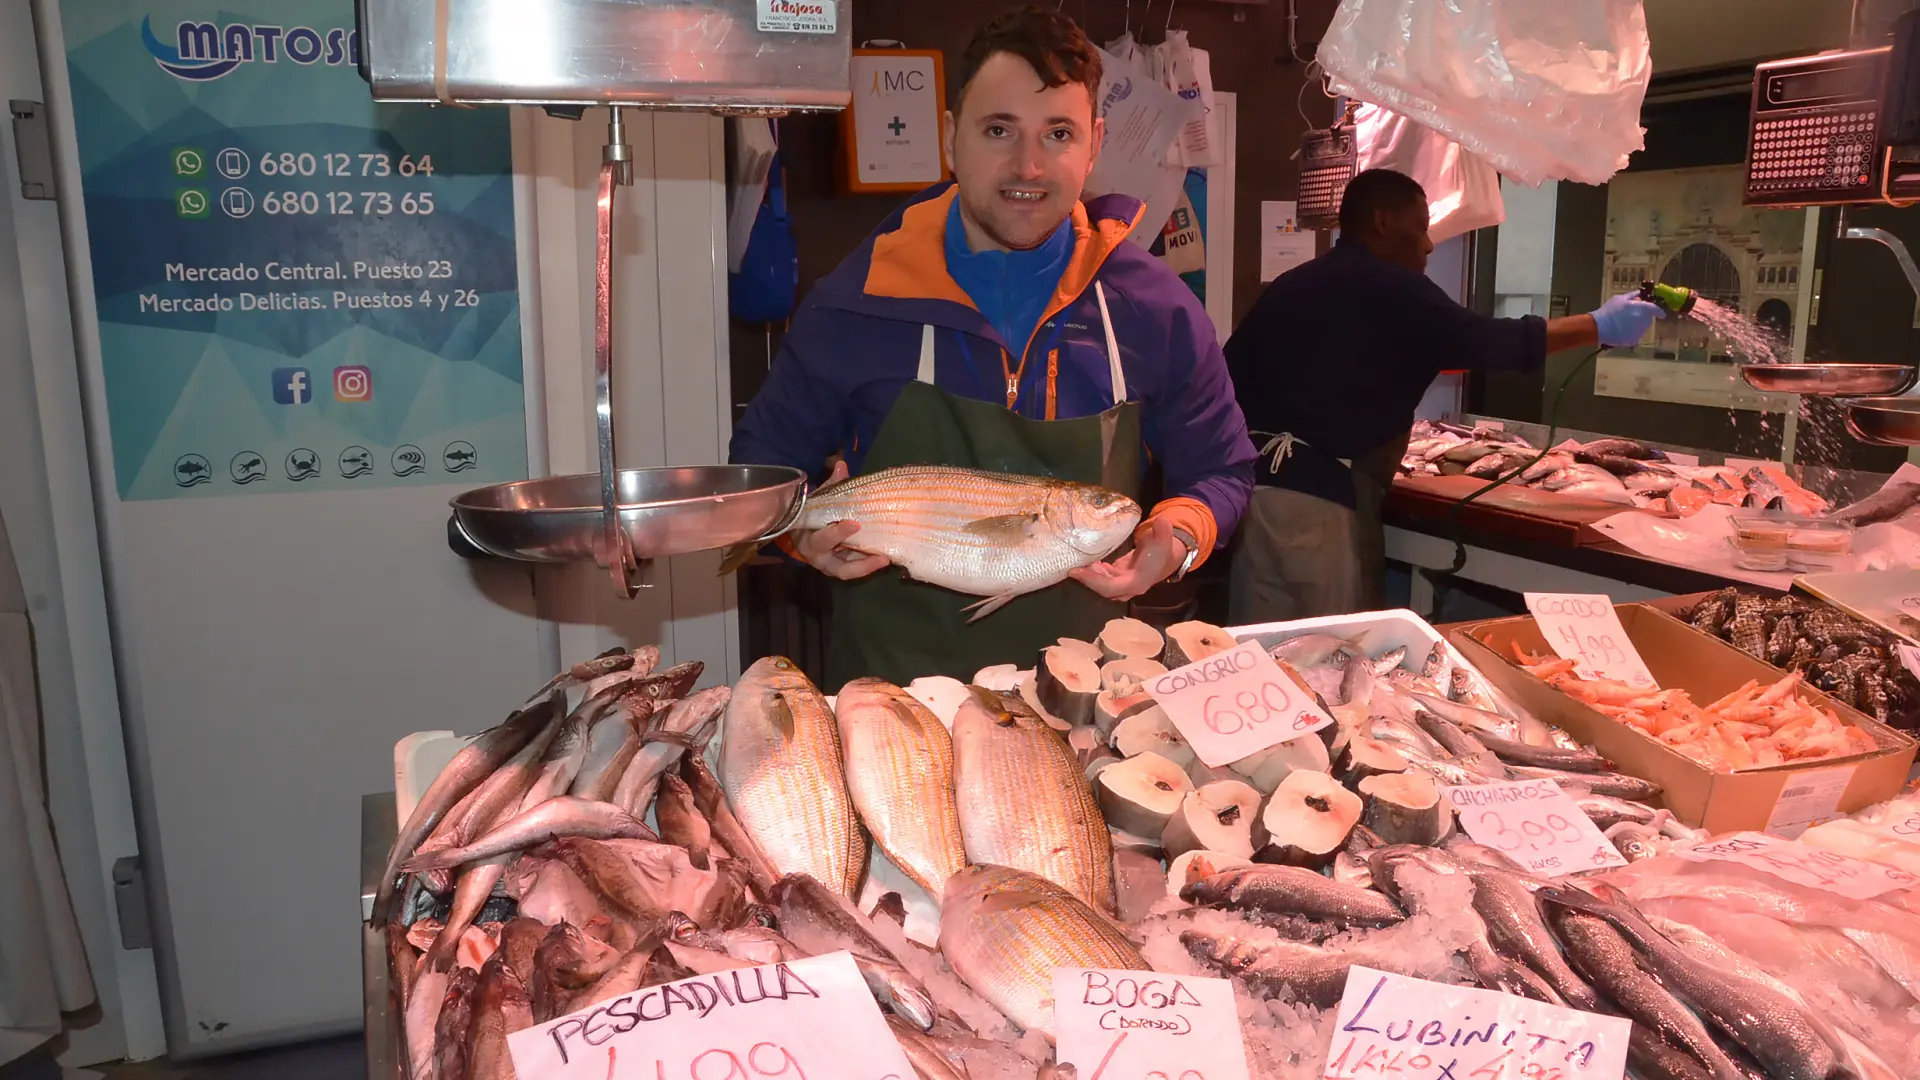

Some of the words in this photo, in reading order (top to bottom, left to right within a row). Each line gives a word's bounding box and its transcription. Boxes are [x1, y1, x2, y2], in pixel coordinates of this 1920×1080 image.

[259, 151, 317, 177] 680
[322, 152, 352, 177] 12
[357, 153, 391, 177] 73
[398, 154, 434, 178] 64
[262, 190, 320, 215] 680
[325, 191, 354, 215] 12
[360, 191, 394, 215] 73
[400, 191, 435, 215] 65
[165, 262, 260, 282] Mercado
[264, 261, 348, 281] Central.
[353, 261, 424, 280] Puesto
[427, 260, 453, 279] 23
[139, 292, 234, 313] Mercado
[239, 291, 328, 312] Delicias.
[333, 291, 414, 310] Puestos
[418, 289, 433, 308] 4
[438, 294, 449, 312] y
[454, 288, 480, 308] 26
[1536, 597, 1608, 618] COCIDO
[1155, 650, 1257, 695] CONGRIO
[1203, 682, 1291, 735] 6,80
[1081, 970, 1202, 1009] BOGA
[546, 963, 820, 1064] PESCADILLA
